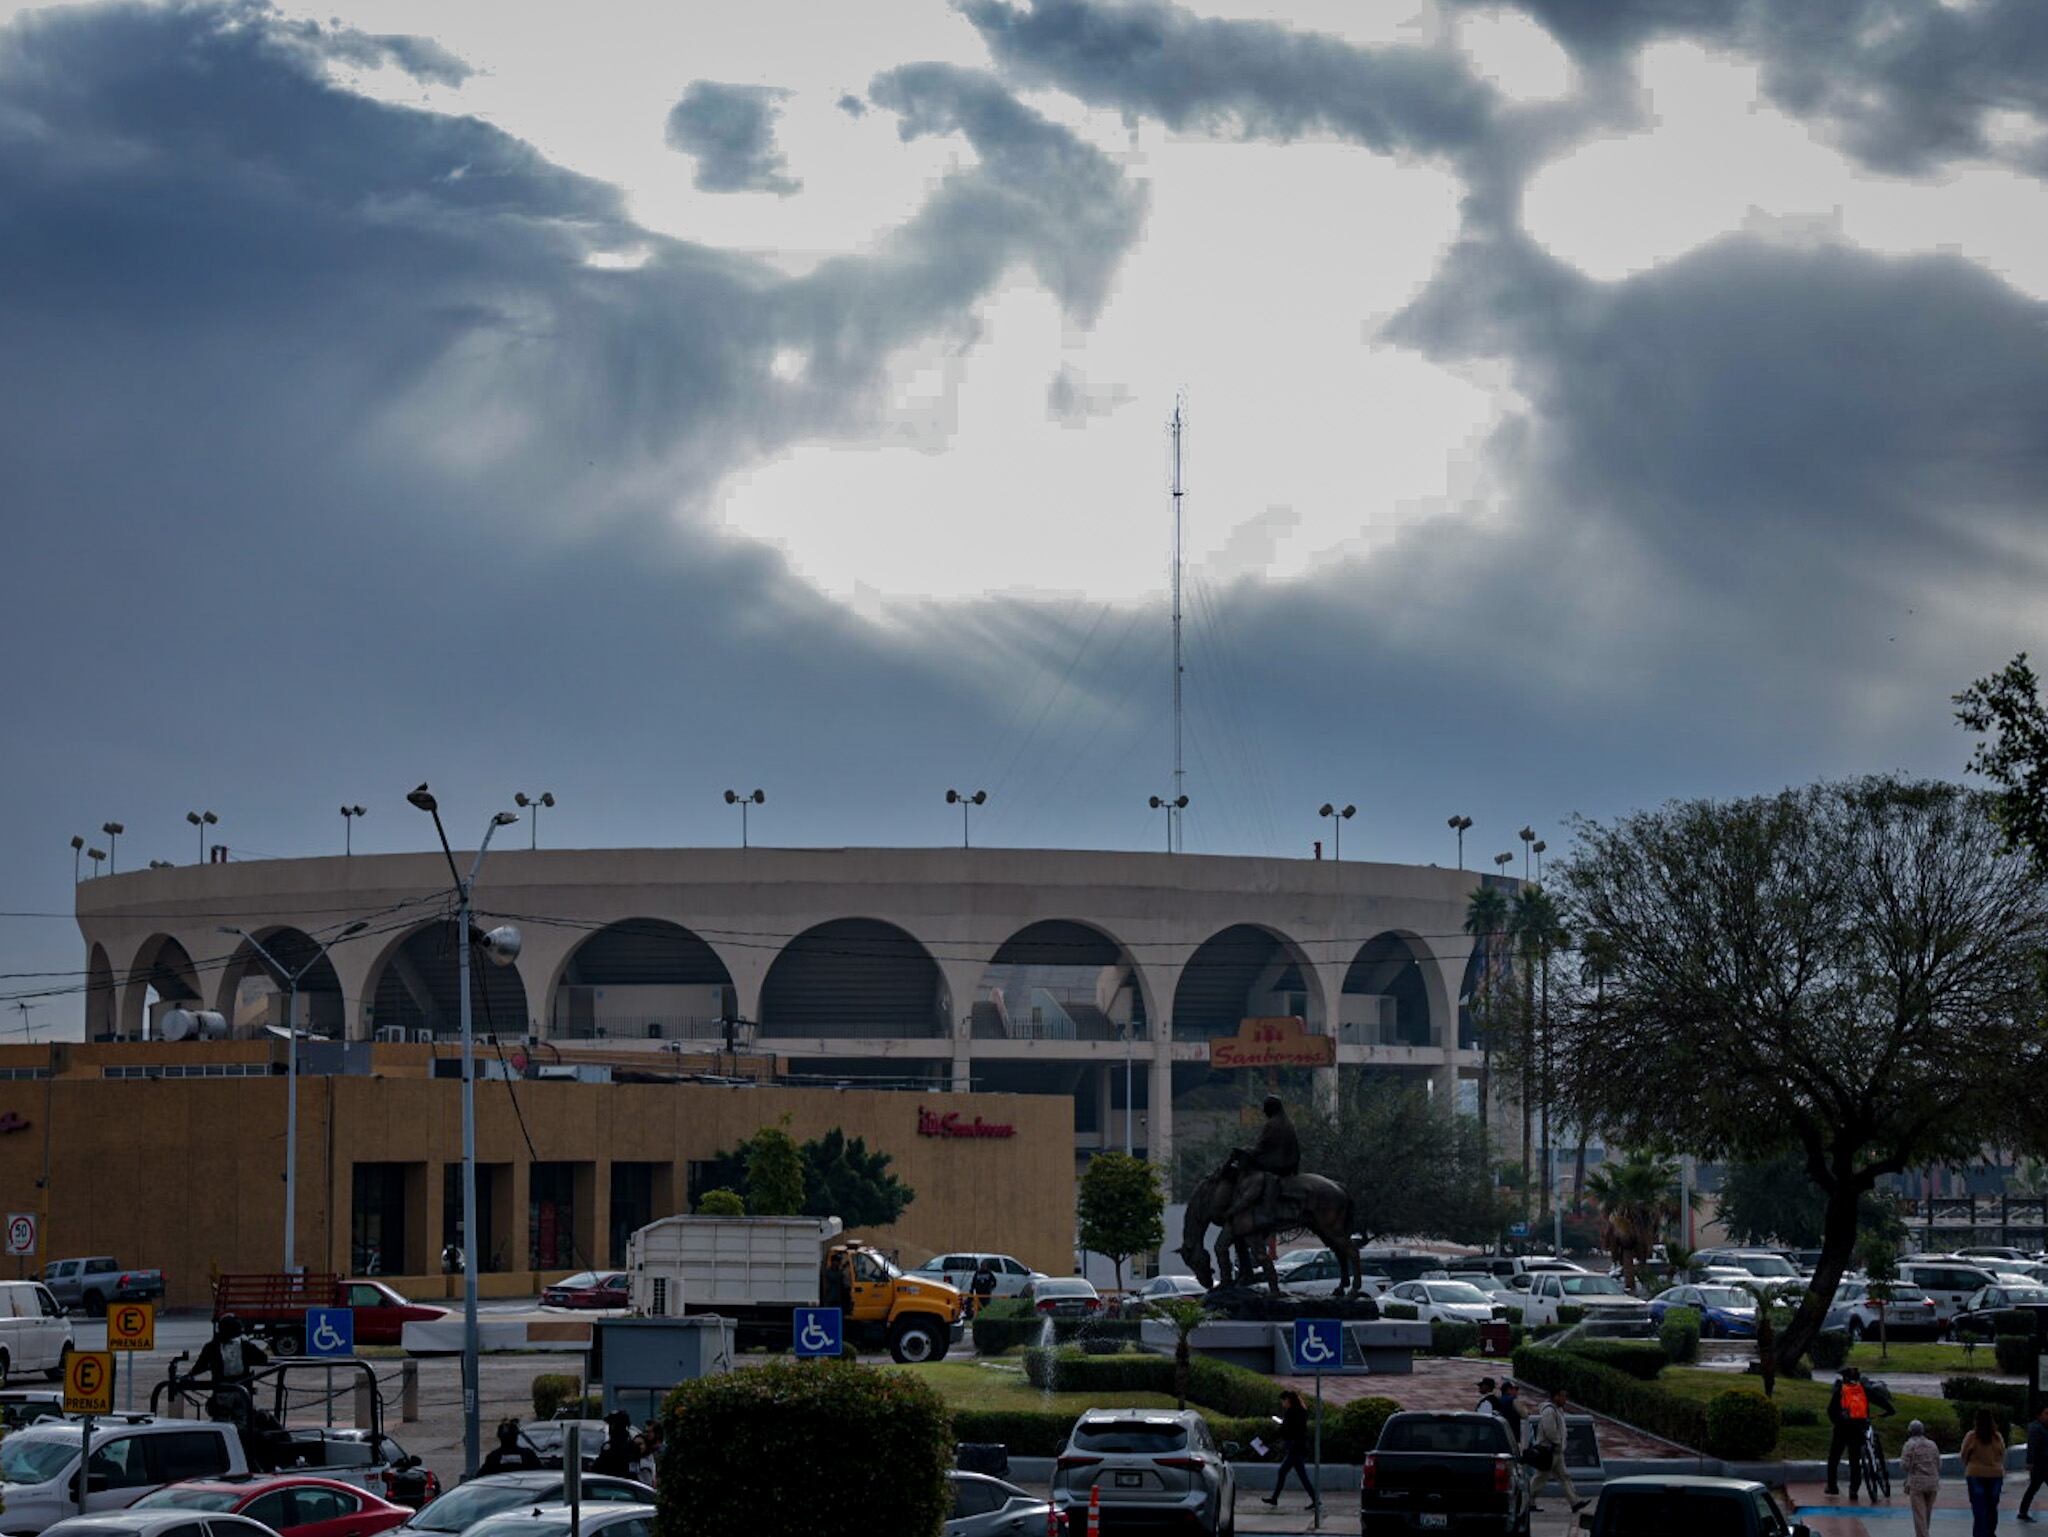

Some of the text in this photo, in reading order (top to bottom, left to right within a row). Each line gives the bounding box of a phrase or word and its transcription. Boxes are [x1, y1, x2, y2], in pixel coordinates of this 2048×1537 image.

[15, 1223, 27, 1238] 50
[124, 1312, 139, 1331] E
[110, 1338, 150, 1348] PRENSA
[81, 1362, 96, 1388] E
[65, 1397, 107, 1409] PRENSA
